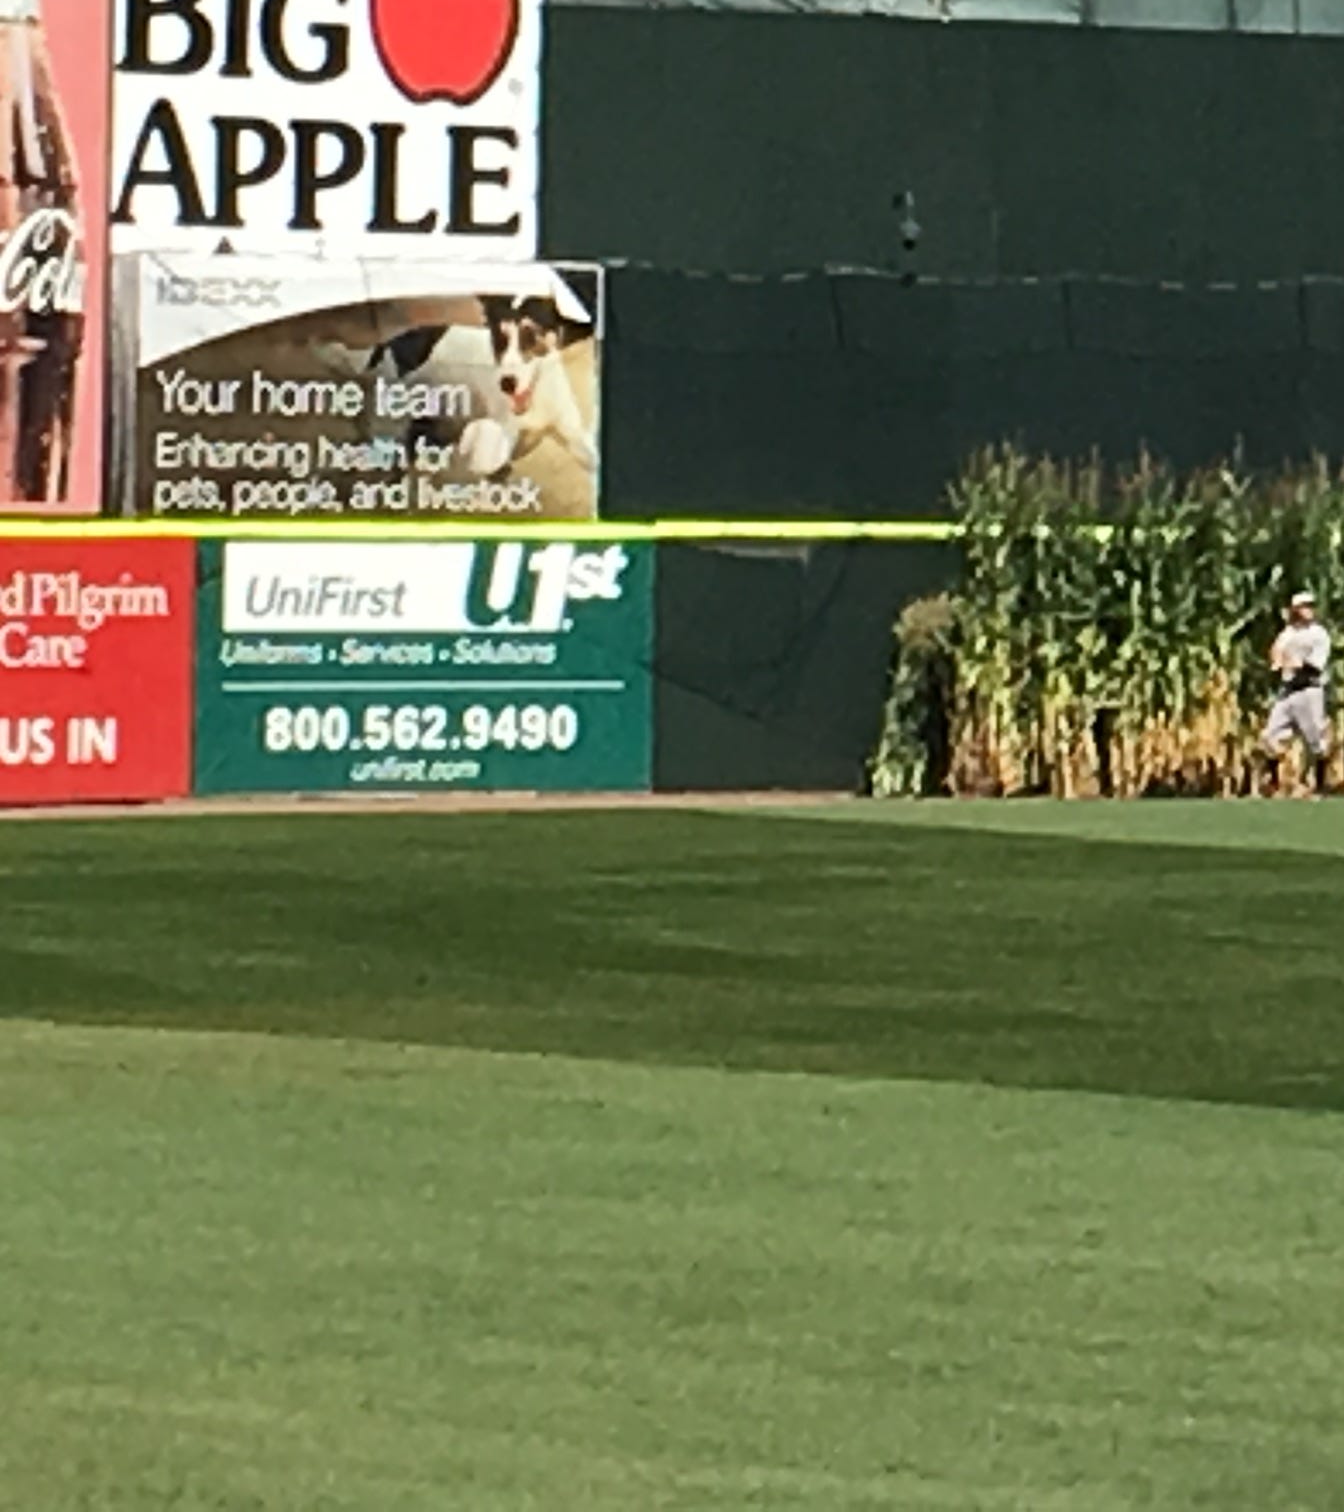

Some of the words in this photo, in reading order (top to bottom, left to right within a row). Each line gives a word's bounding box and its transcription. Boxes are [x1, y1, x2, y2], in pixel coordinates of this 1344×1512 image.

[109, 97, 522, 236] APPLE
[155, 369, 241, 416] Your
[252, 370, 363, 416] home
[374, 374, 472, 418] team
[154, 431, 311, 477] Enhancing
[318, 433, 406, 471] health
[414, 435, 454, 472] for
[349, 478, 410, 511] and
[417, 477, 543, 512] livestock
[29, 570, 170, 631] Pilgrim
[244, 574, 408, 618] UniFirst
[0, 621, 88, 668] Care
[340, 638, 434, 666] Services
[453, 637, 557, 666] Solutions
[0, 717, 56, 765] US
[66, 717, 119, 765] IN
[265, 704, 578, 751] 800.562.9490
